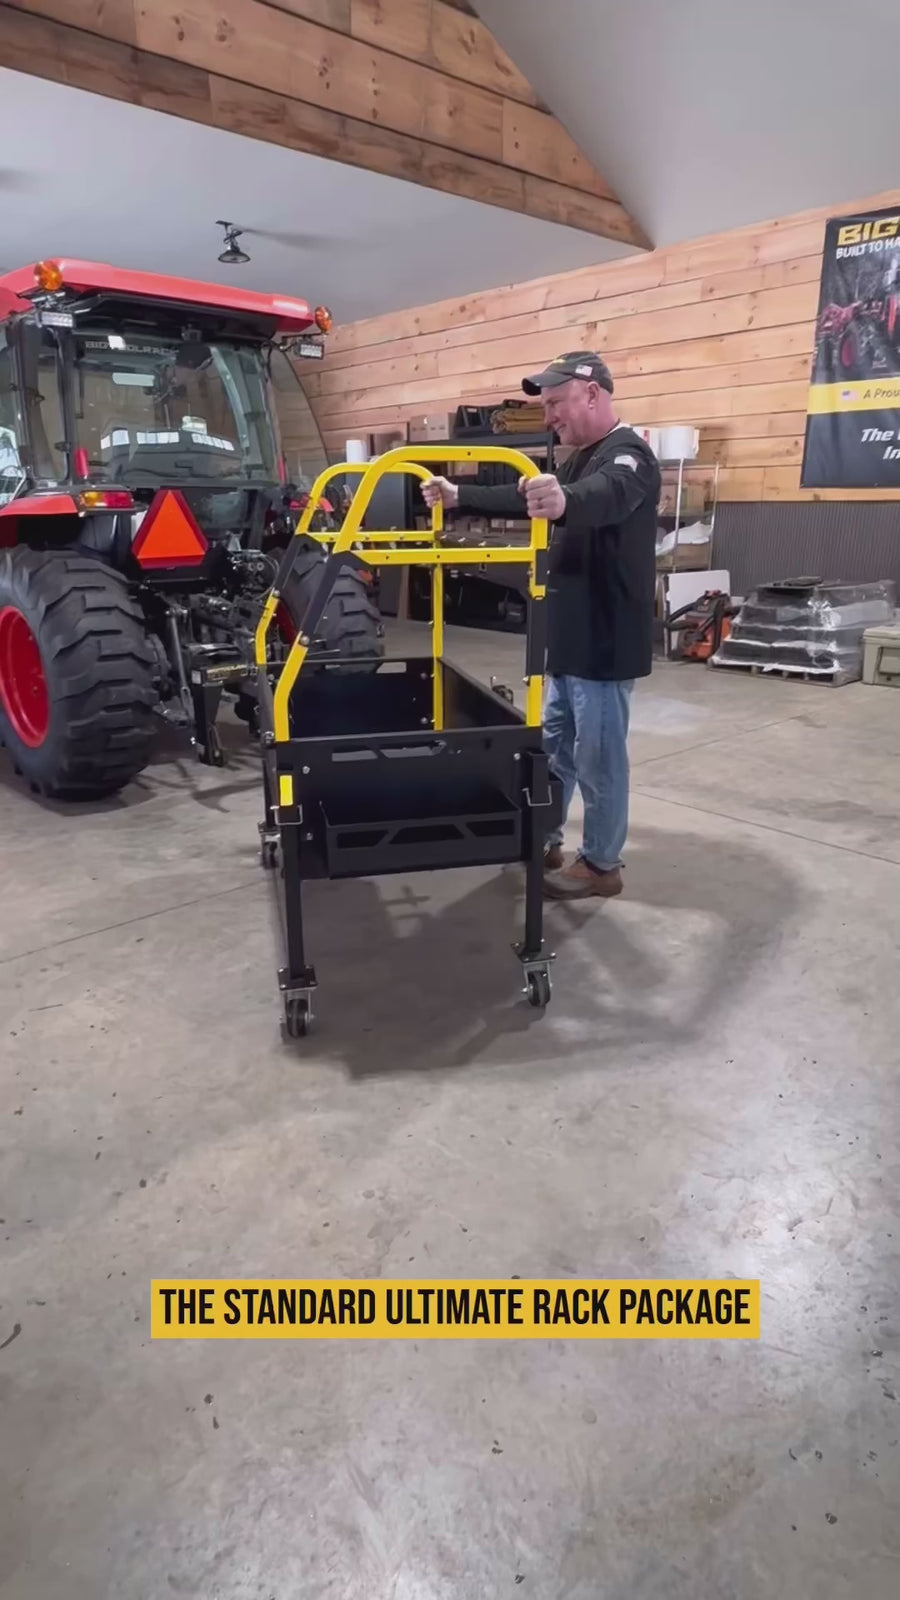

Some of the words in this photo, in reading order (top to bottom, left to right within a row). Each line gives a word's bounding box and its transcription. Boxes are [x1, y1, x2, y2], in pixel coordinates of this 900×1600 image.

[837, 216, 900, 246] BIG
[836, 243, 867, 259] BUILT
[868, 240, 883, 254] TO
[863, 389, 871, 399] A
[861, 428, 894, 442] The
